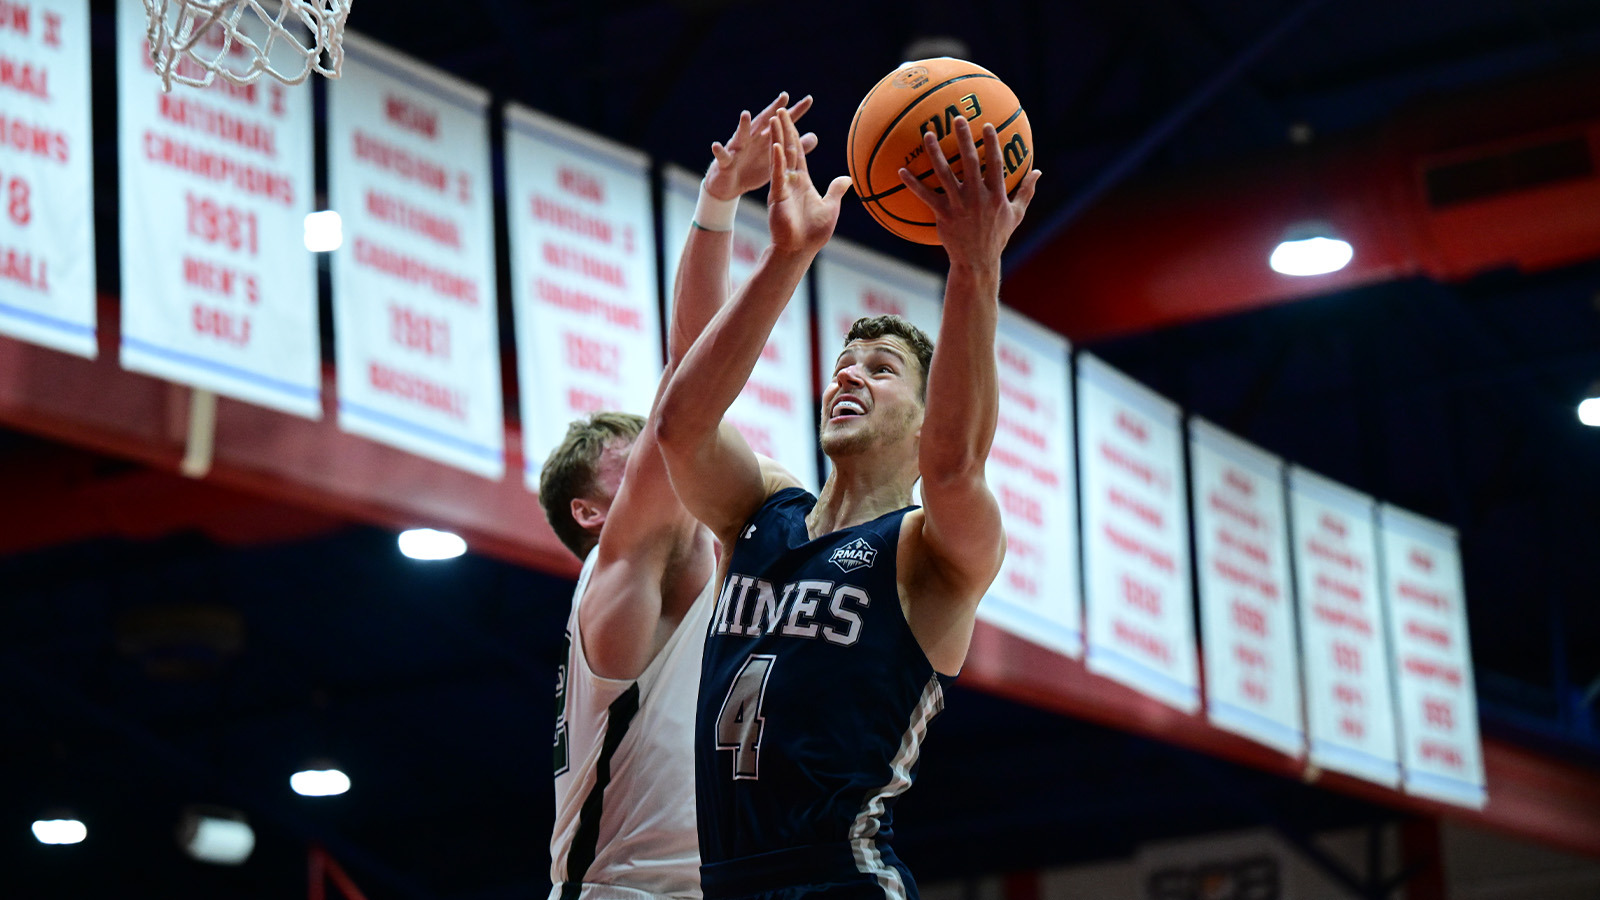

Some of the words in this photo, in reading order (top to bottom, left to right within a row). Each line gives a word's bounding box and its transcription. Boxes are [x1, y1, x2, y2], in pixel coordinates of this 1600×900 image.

[143, 130, 294, 207] CHAMPIONS
[833, 549, 874, 564] RMAC
[710, 573, 872, 647] MINES
[715, 653, 777, 780] 4
